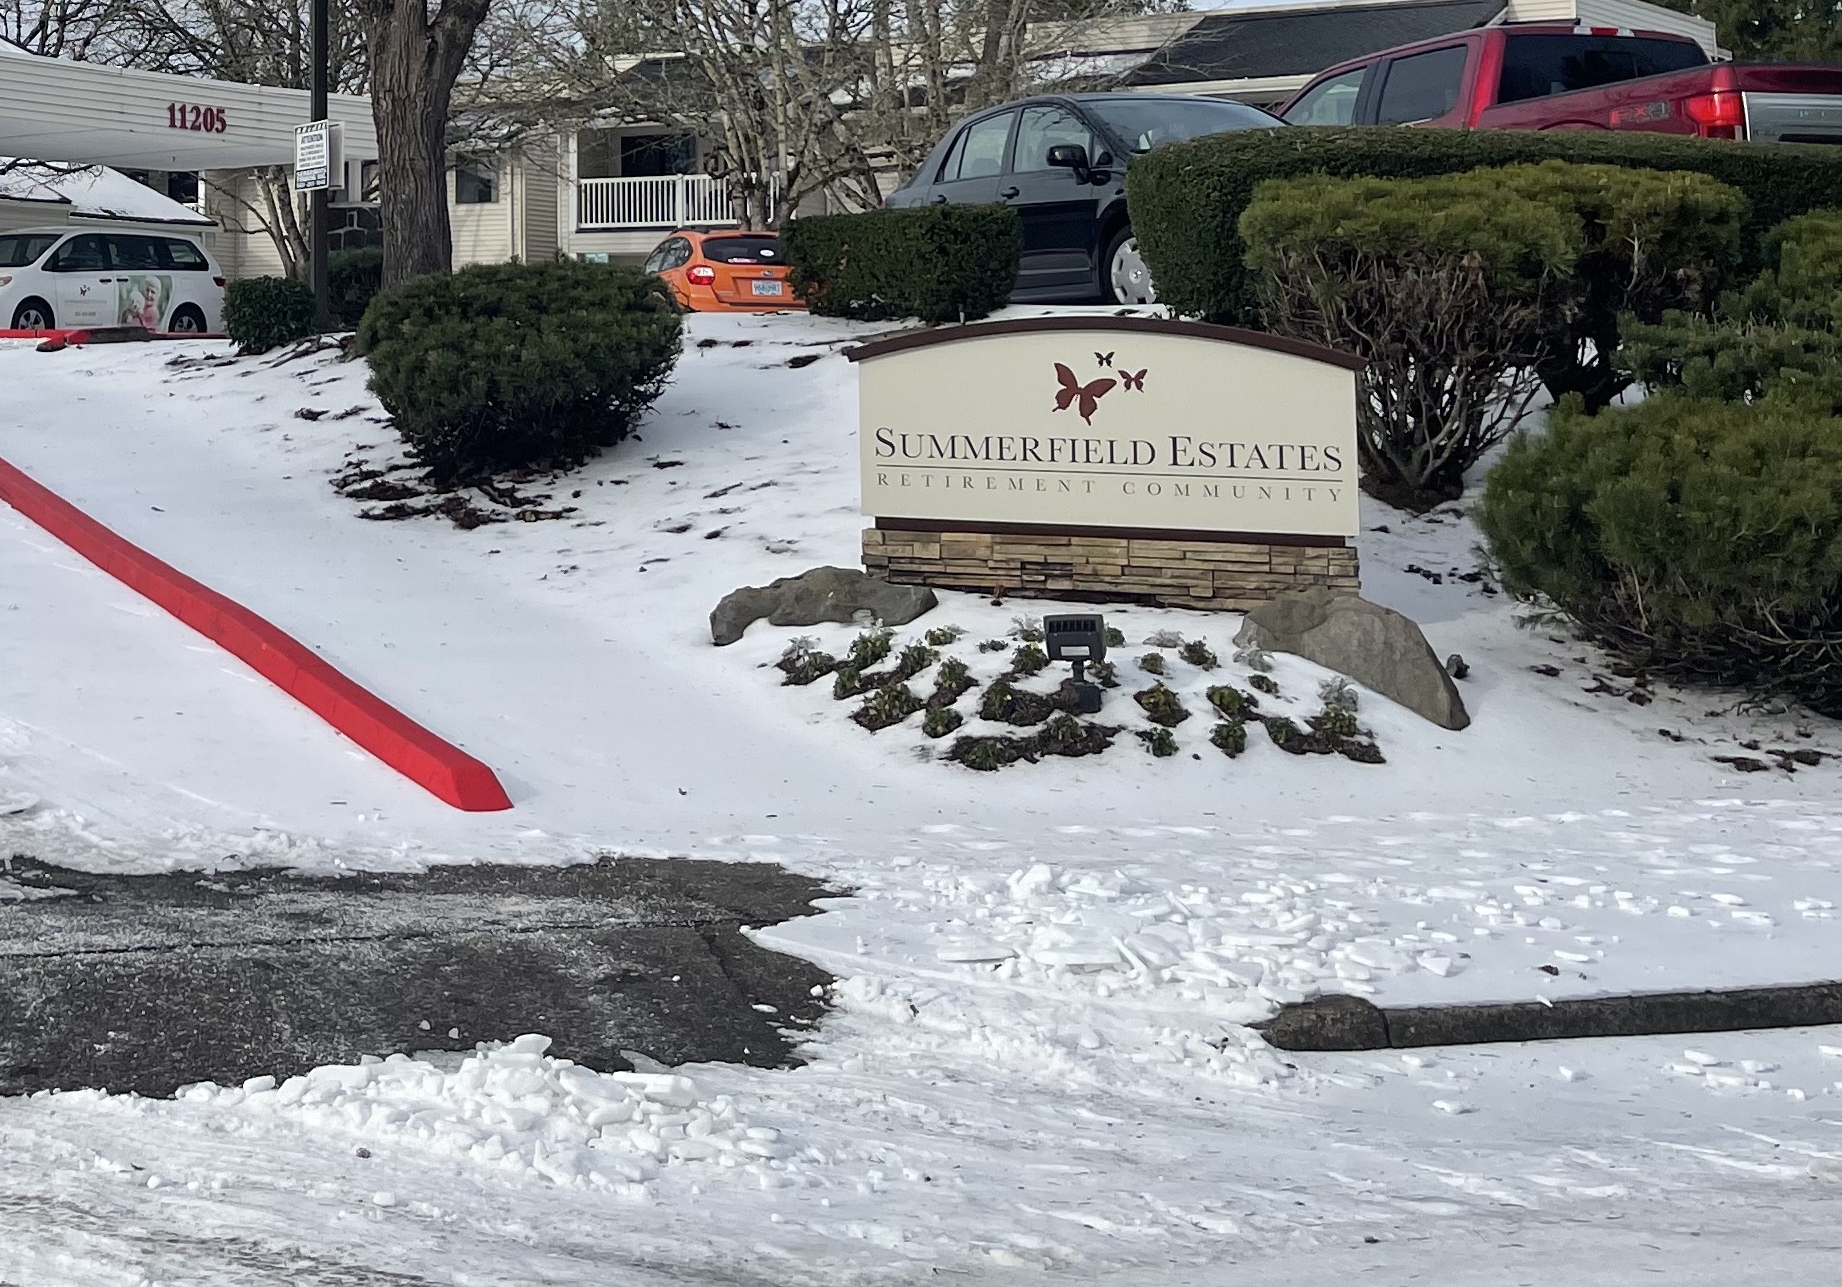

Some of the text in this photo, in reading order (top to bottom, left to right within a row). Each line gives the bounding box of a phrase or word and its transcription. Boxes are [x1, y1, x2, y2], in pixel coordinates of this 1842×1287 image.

[167, 103, 227, 133] 11205
[875, 427, 1343, 472] SUMMERFIELD ESTATES
[877, 473, 1342, 502] RETIREMENT COMMUNITY
